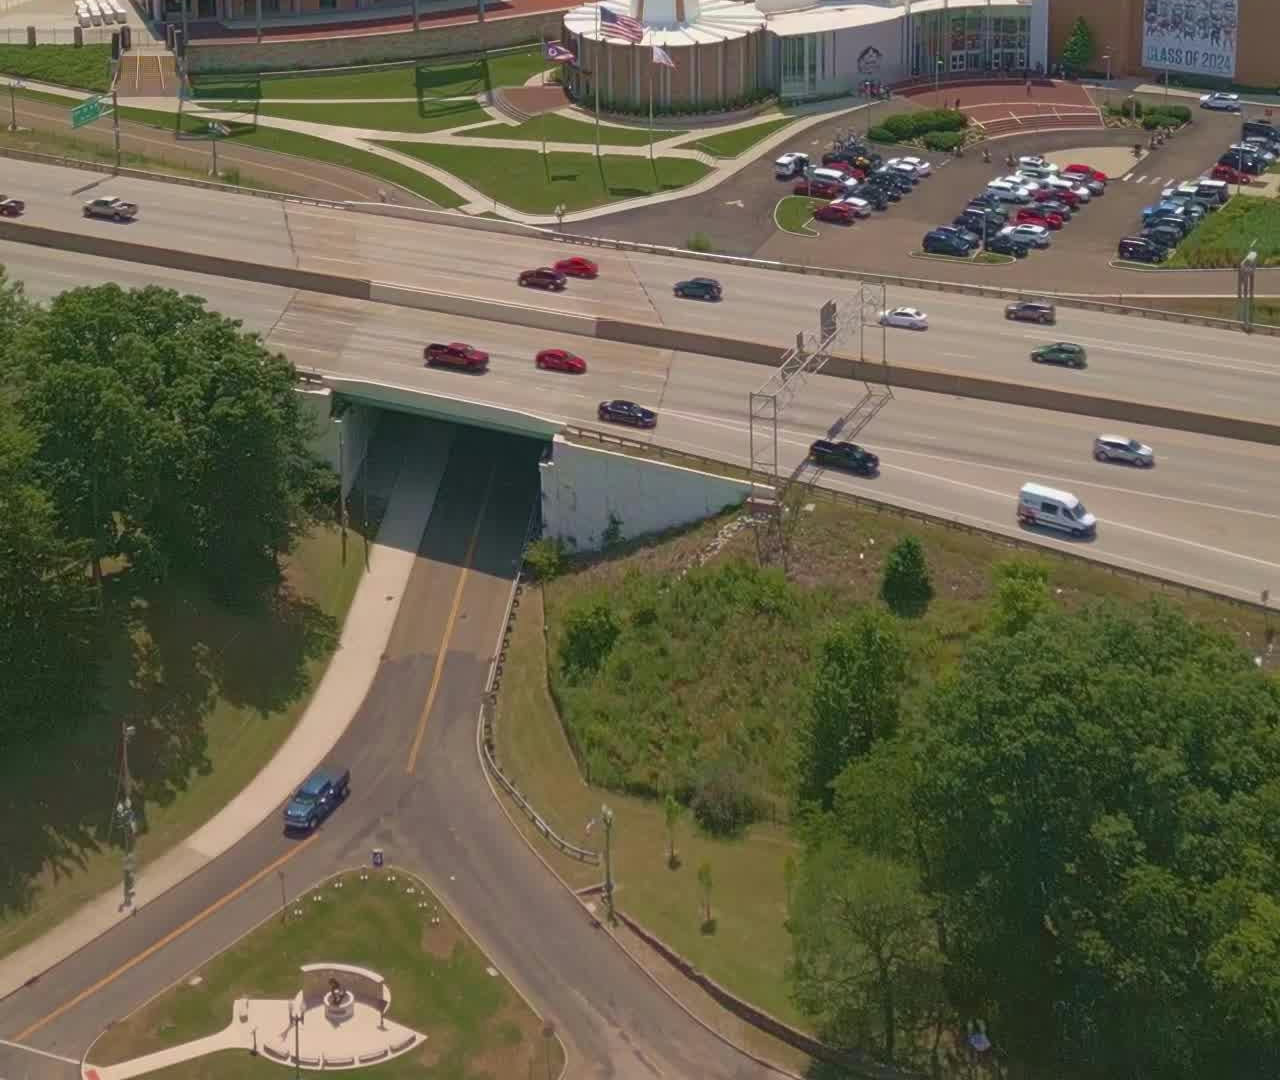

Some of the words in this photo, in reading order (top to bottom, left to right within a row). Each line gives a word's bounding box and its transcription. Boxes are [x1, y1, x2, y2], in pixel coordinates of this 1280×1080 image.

[1147, 47, 1182, 65] CLASS
[1185, 50, 1199, 68] OF
[1201, 52, 1231, 70] 2024
